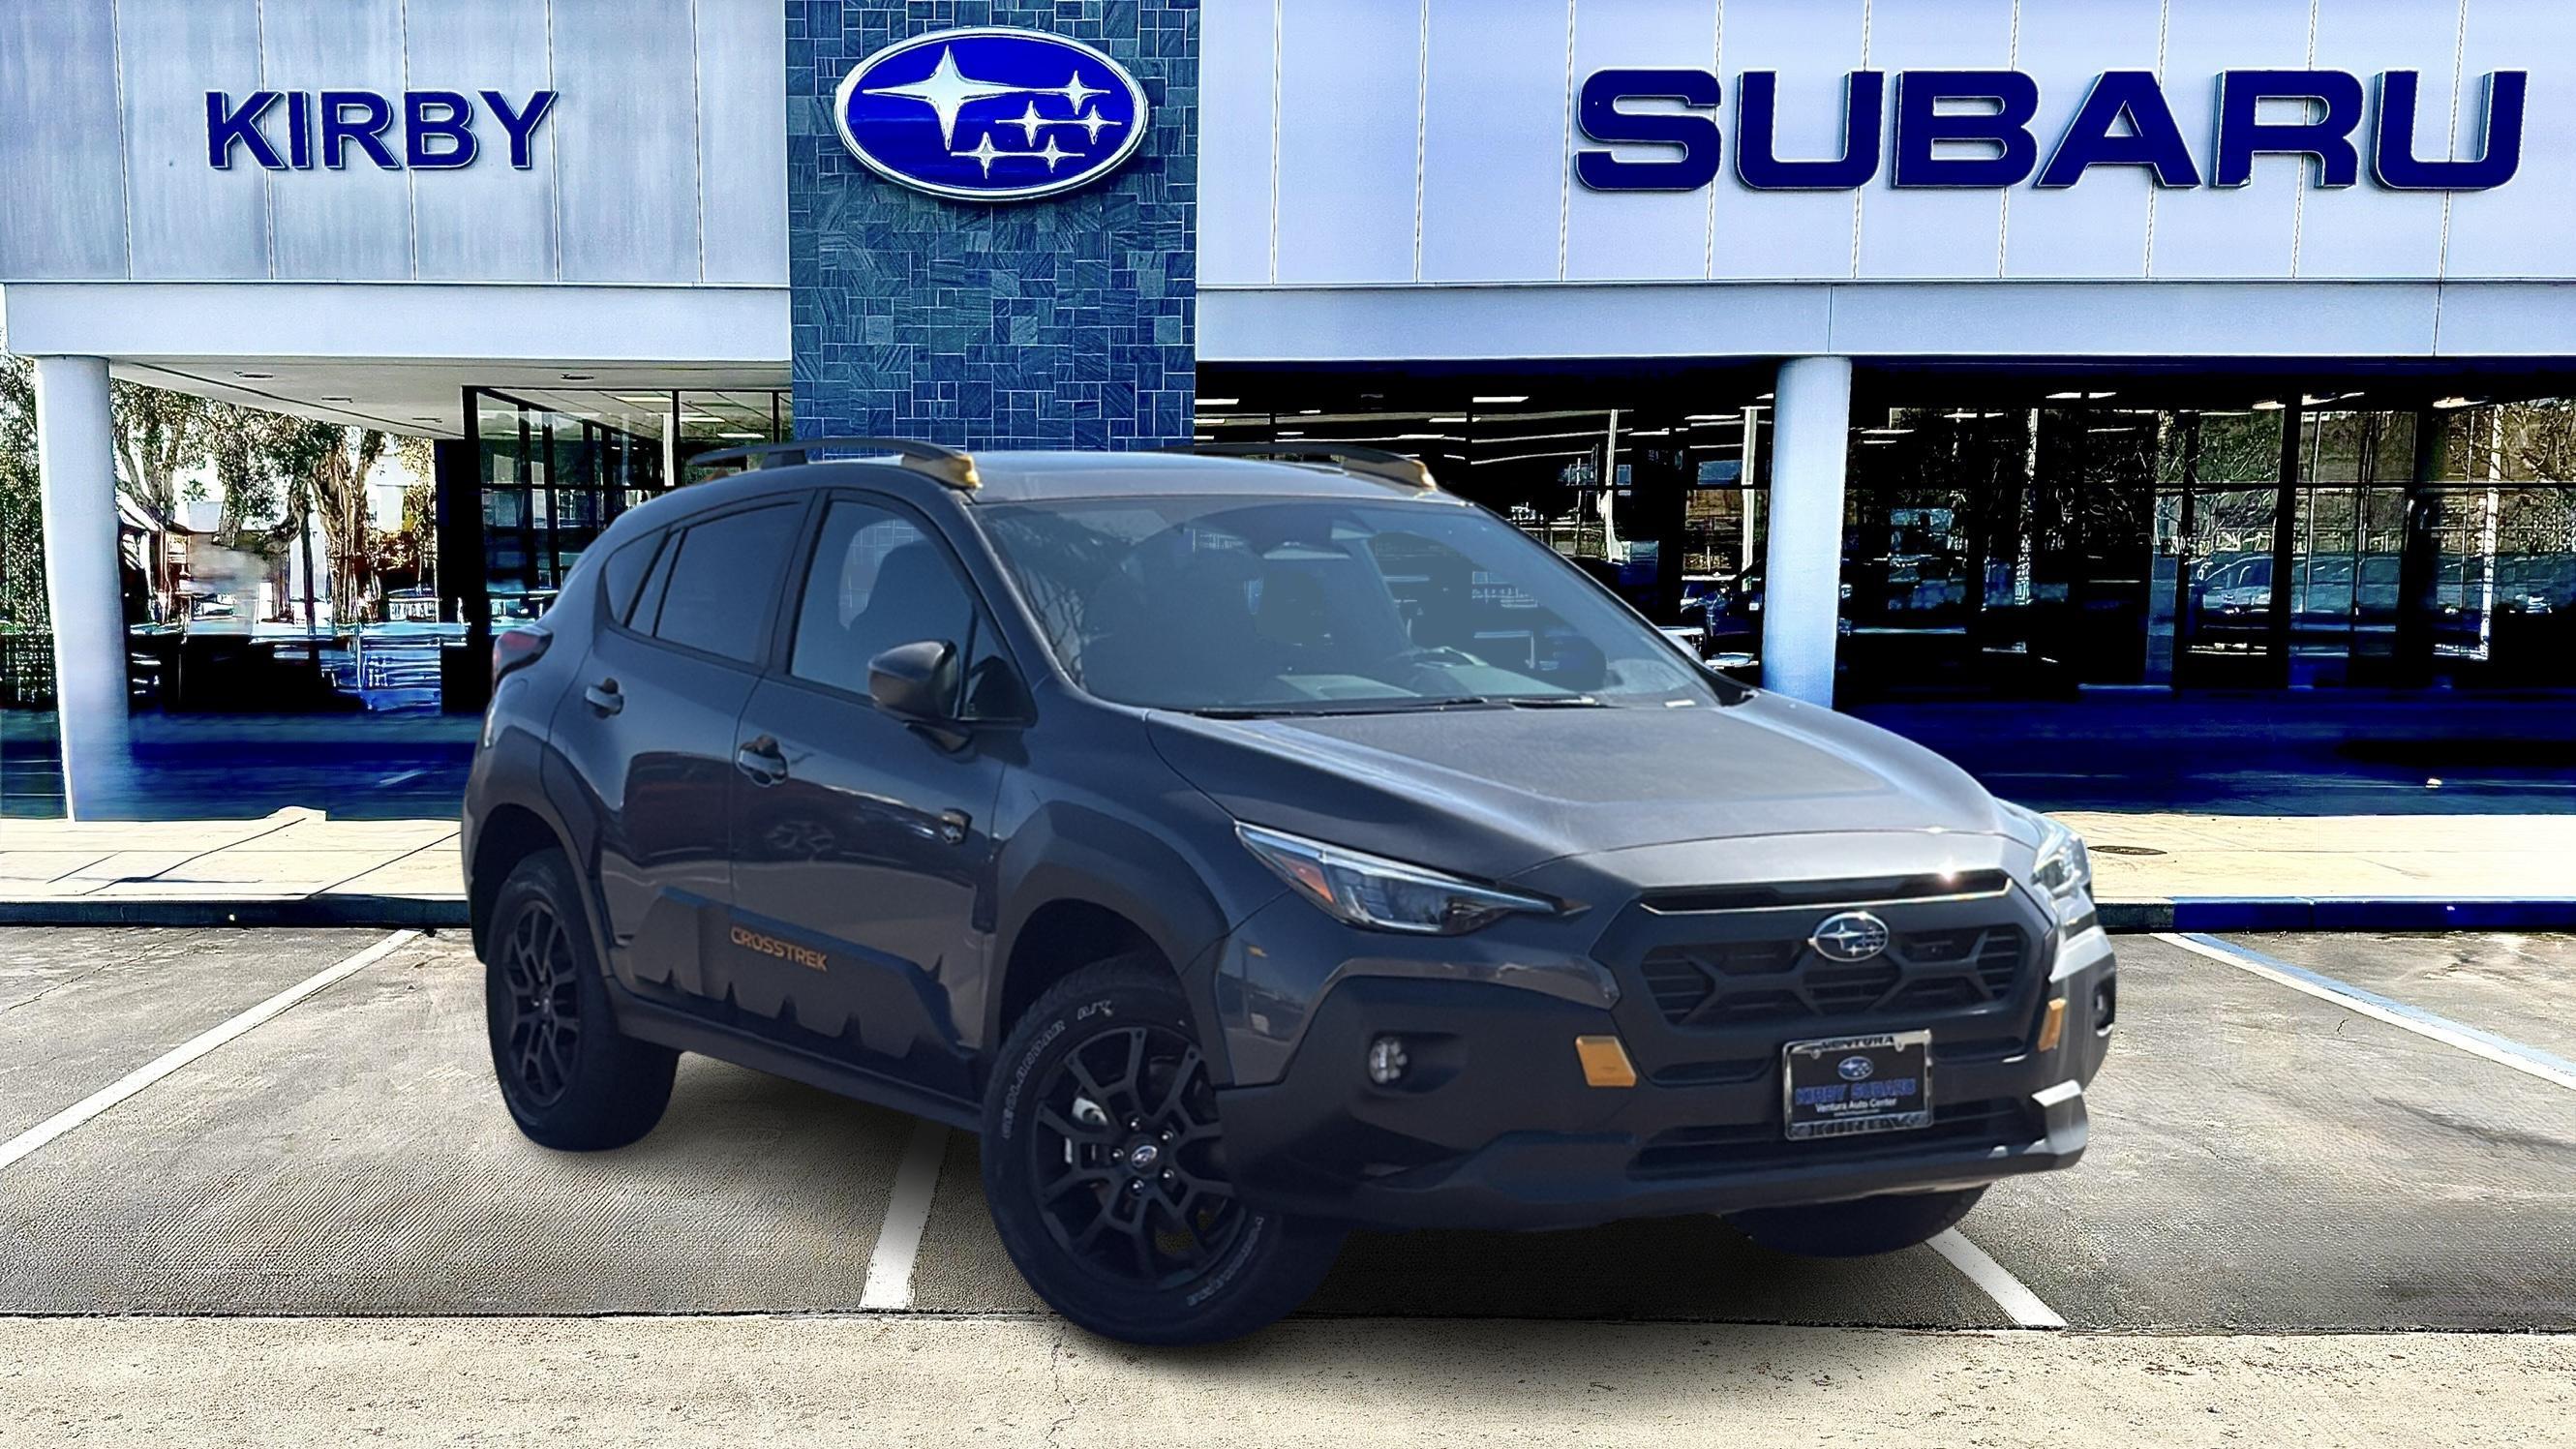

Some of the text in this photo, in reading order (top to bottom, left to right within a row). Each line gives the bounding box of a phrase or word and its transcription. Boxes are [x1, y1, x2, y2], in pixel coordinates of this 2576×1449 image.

[205, 90, 559, 170] KIRBY
[1575, 69, 2528, 191] SUBARU
[730, 926, 828, 971] CROSSTREK
[1822, 1036, 1894, 1050] VENTURA
[1815, 1101, 1847, 1113] Ventura
[1848, 1099, 1869, 1110] Auto
[1869, 1097, 1898, 1109] Center
